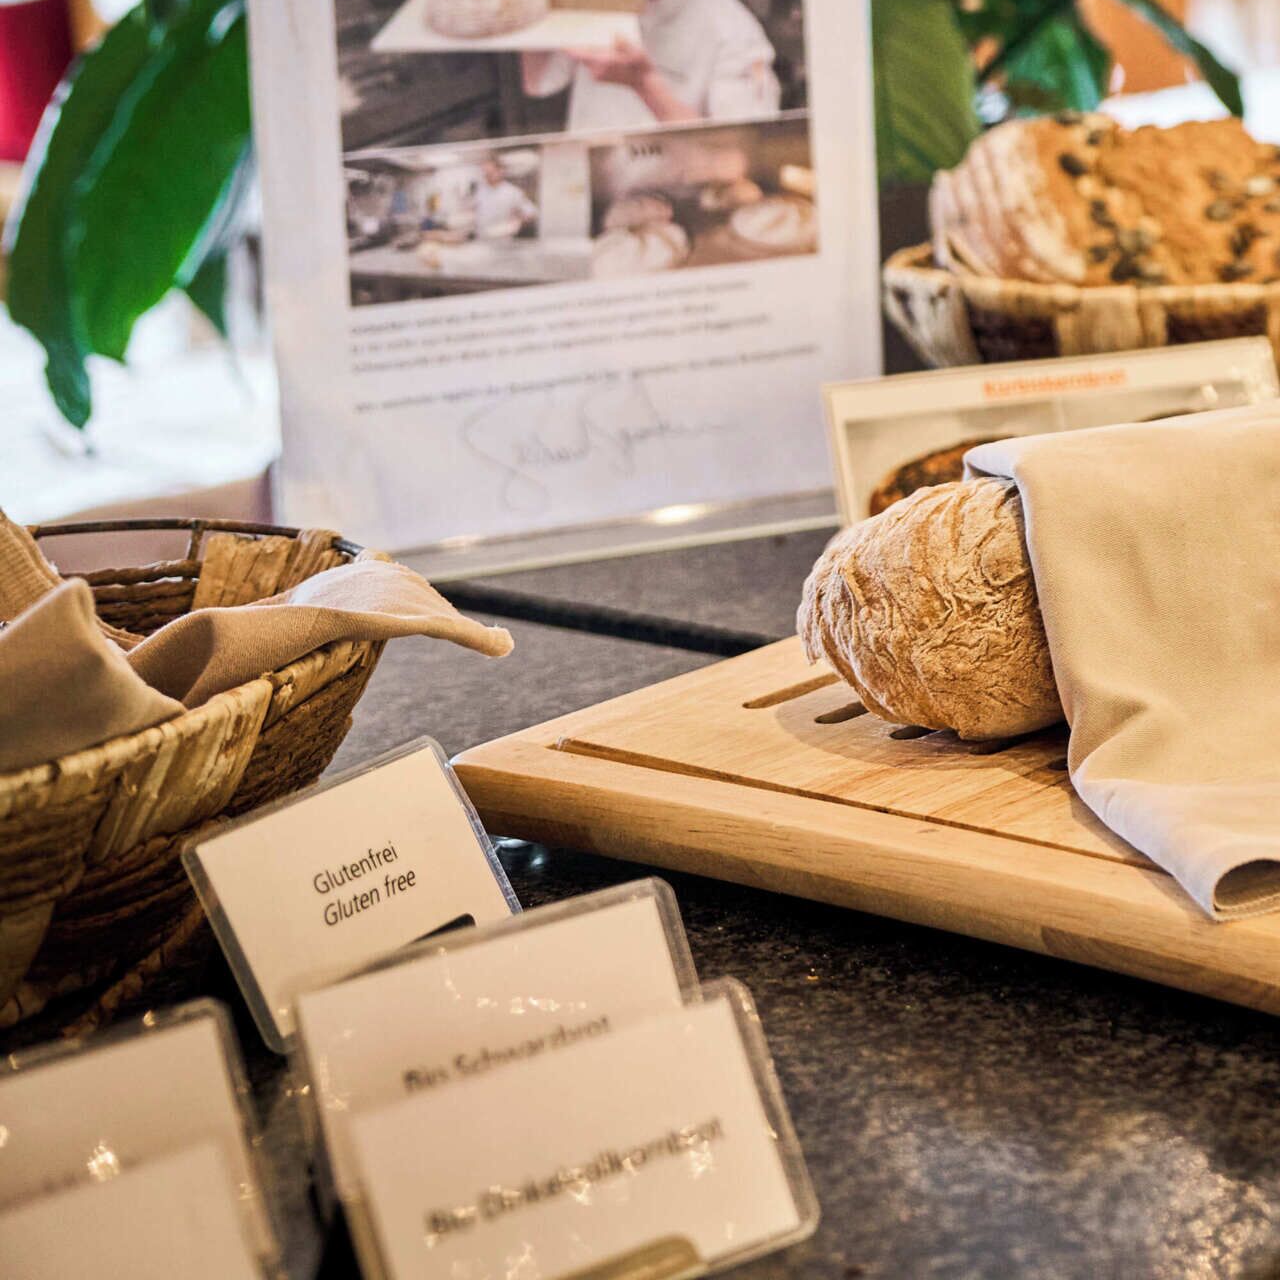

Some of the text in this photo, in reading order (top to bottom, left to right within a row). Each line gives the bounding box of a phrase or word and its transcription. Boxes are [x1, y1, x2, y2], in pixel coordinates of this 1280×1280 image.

[313, 840, 399, 894] Glutenfrei
[324, 870, 417, 926] Gluten free
